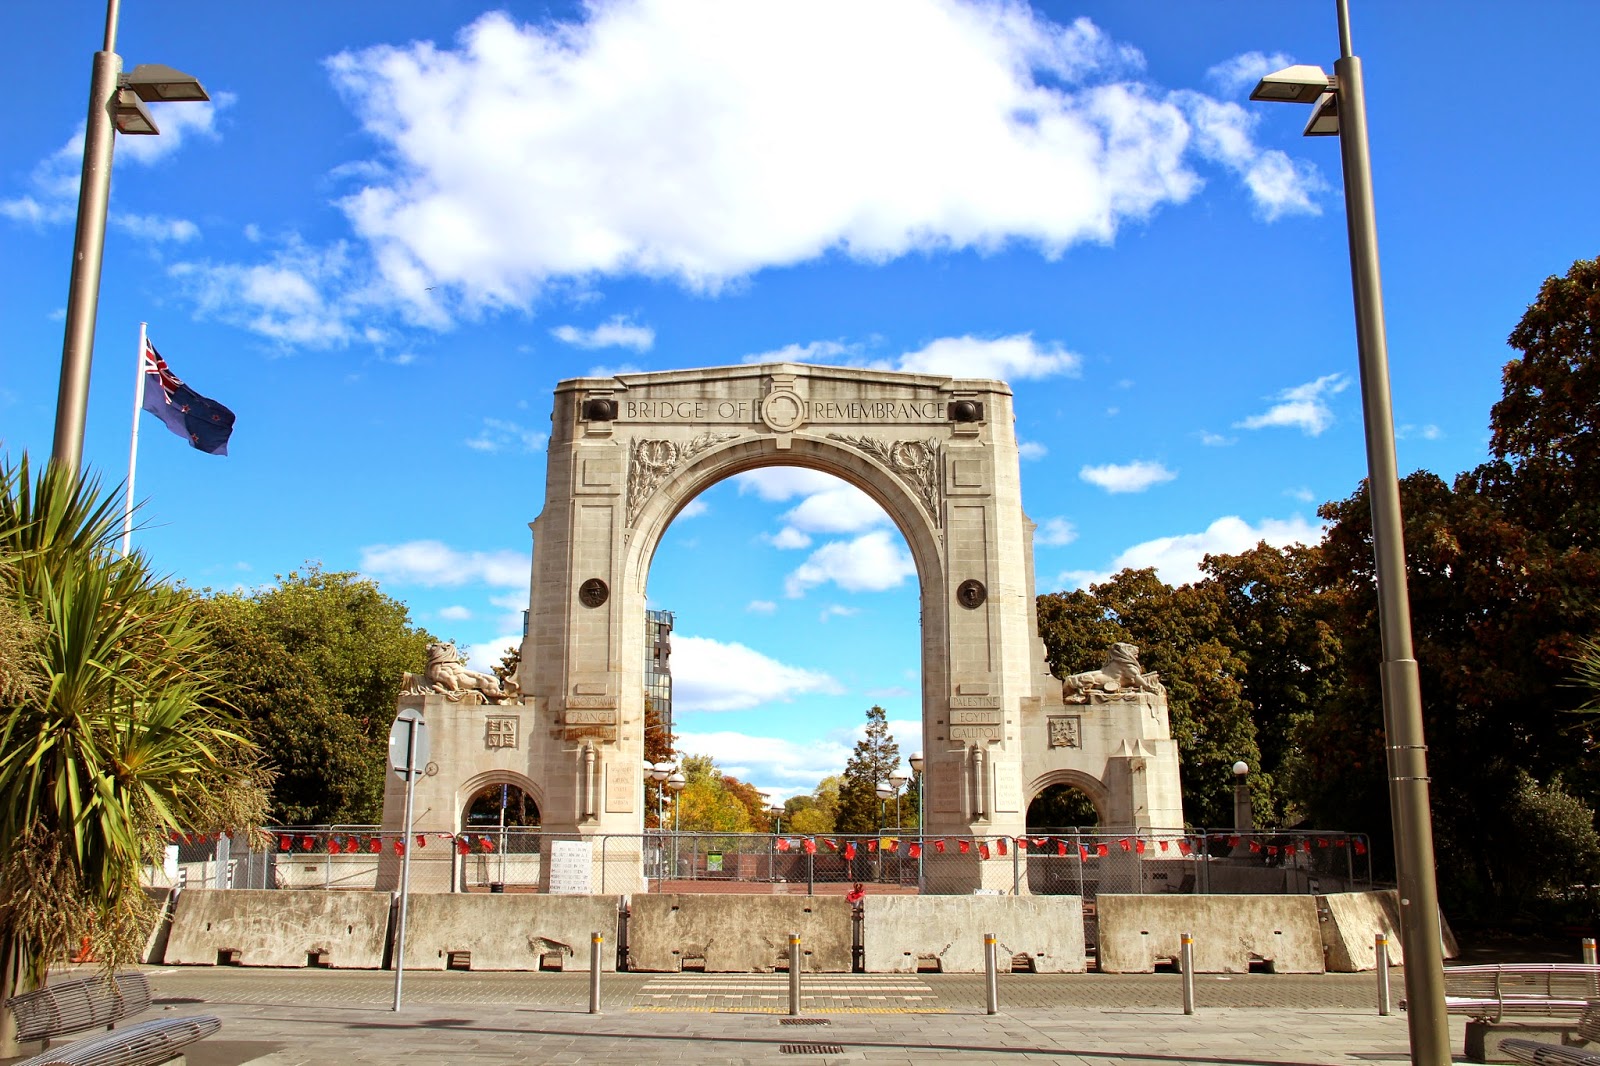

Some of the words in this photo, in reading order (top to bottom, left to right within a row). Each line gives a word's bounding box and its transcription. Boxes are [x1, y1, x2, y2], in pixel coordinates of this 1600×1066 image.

[626, 401, 704, 419] BRIDGE
[717, 401, 747, 419] OF
[814, 402, 945, 419] REMEMBRANCE
[567, 697, 617, 707] MESOPOTAMIA
[952, 697, 998, 707] PALESTINE
[571, 711, 612, 722] FRANCE
[960, 712, 992, 722] EGYPT
[567, 728, 614, 739] BELGIUM
[952, 727, 1000, 739] GALLIPOLI
